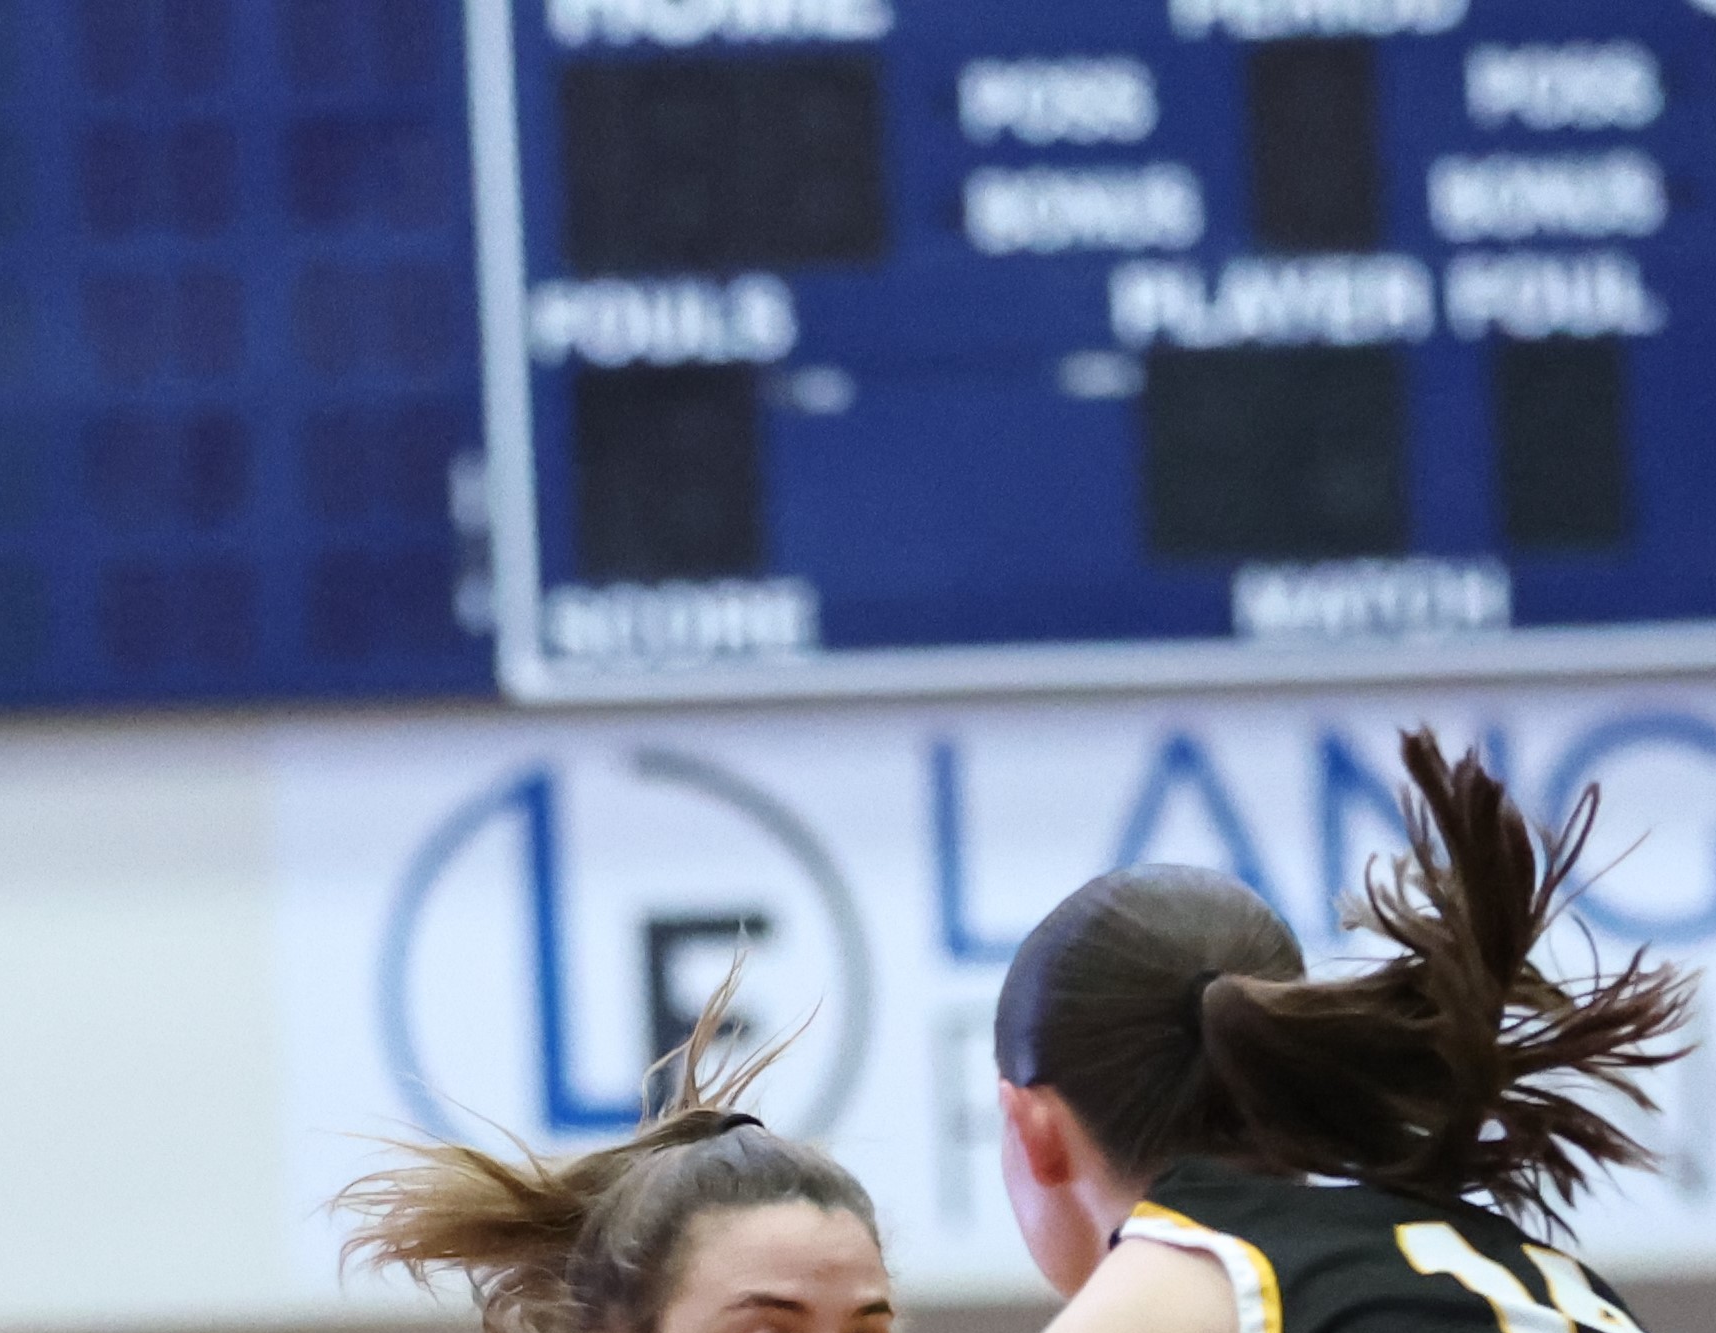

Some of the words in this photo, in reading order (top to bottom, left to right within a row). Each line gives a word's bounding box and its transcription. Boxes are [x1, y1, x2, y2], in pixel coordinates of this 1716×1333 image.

[958, 55, 1158, 146] POSS
[1465, 42, 1665, 131] POSS
[965, 162, 1205, 257] BONUS
[1428, 147, 1668, 243] BONUS
[528, 272, 797, 367] FOULS
[1109, 254, 1435, 348] PLAYER
[1445, 247, 1669, 340] FOUL
